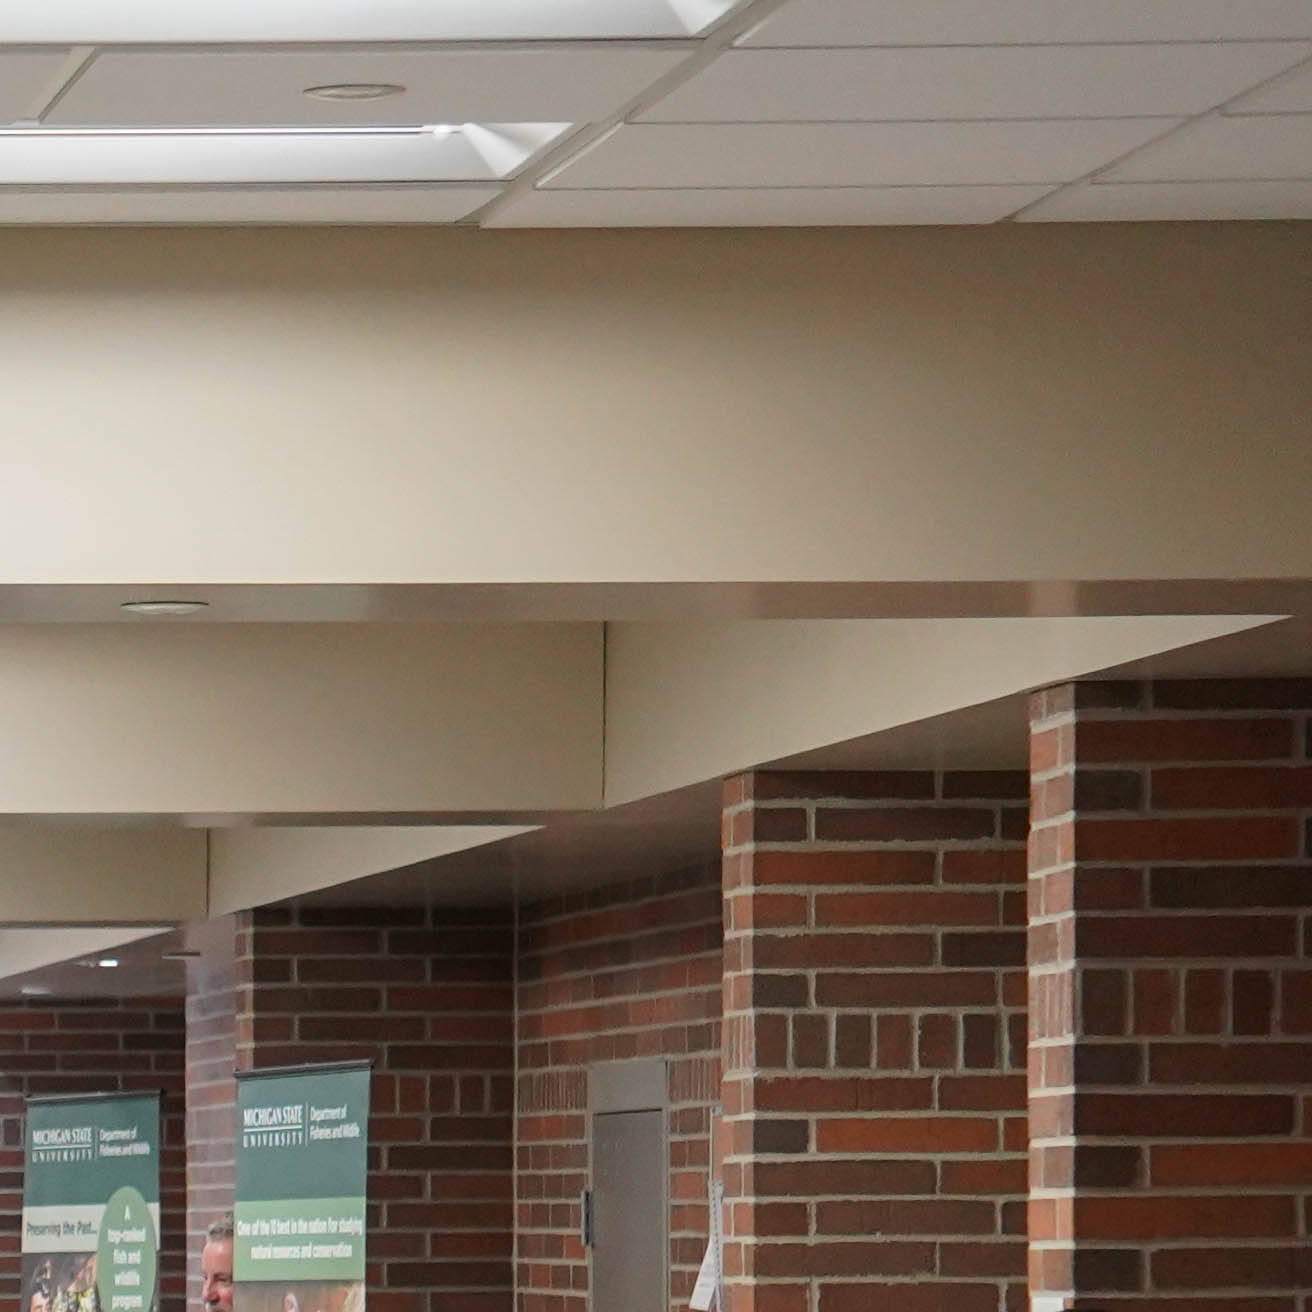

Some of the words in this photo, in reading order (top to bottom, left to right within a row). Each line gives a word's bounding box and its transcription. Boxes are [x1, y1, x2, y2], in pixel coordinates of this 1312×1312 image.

[243, 1107, 281, 1127] MICHIGAN
[282, 1105, 303, 1124] STATE
[310, 1106, 340, 1122] Department
[33, 1129, 71, 1145] MICHIGAN
[72, 1127, 92, 1144] STATE
[243, 1132, 304, 1148] UNIVERSITY
[32, 1149, 92, 1163] UNIVERSITY
[124, 1205, 130, 1220] A
[63, 1220, 75, 1234] the
[237, 1221, 251, 1236] One
[252, 1219, 260, 1235] of
[259, 1219, 270, 1235] the
[327, 1217, 338, 1233] for
